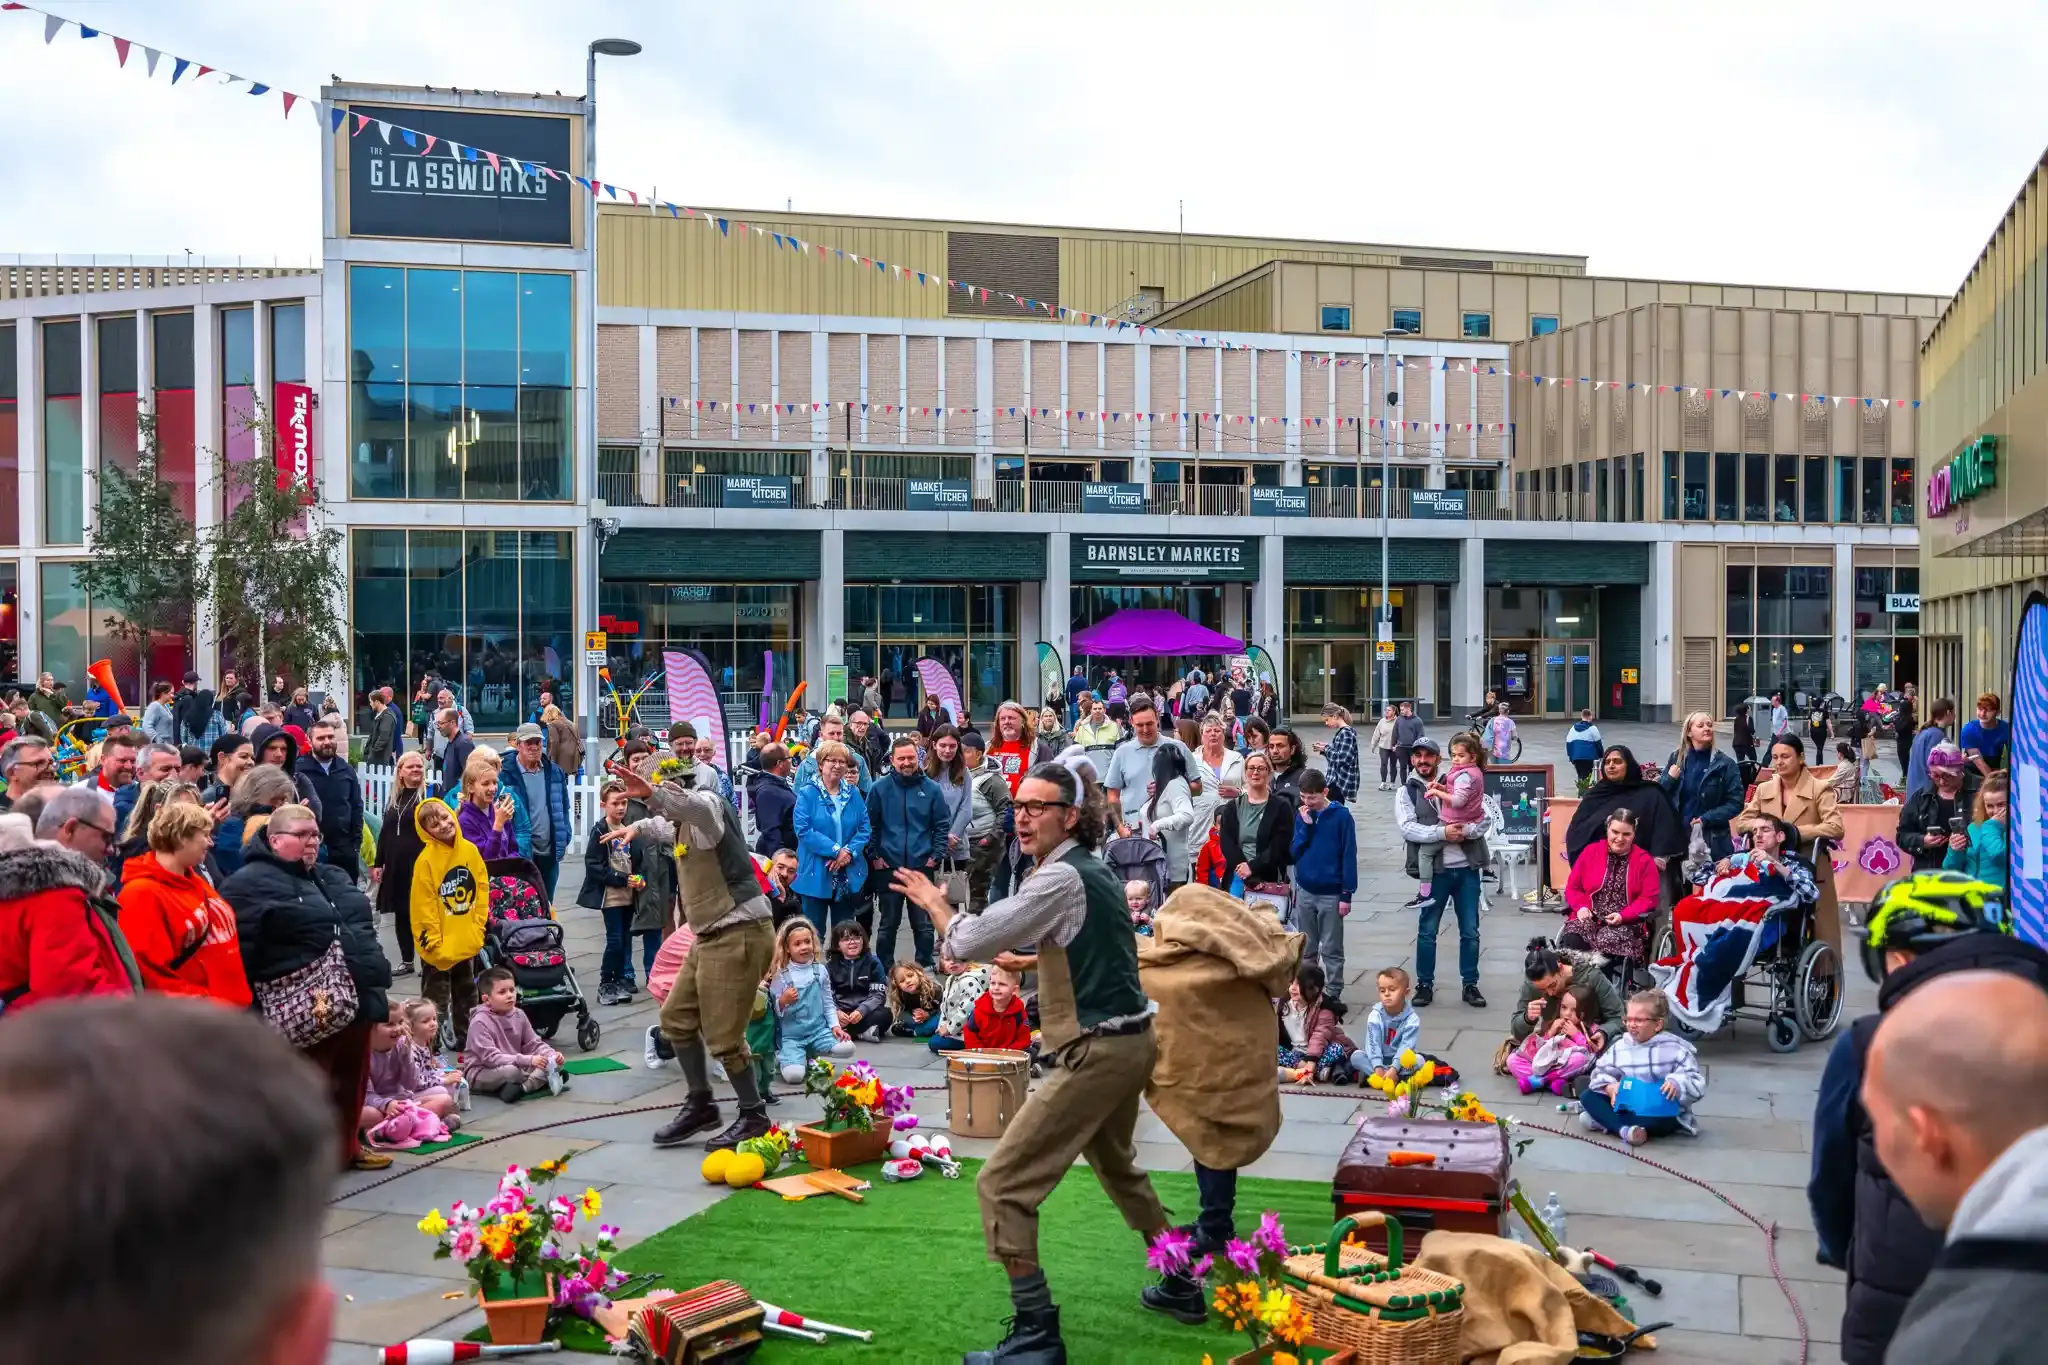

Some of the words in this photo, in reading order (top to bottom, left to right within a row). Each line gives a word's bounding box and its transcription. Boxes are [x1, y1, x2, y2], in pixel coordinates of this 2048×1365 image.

[370, 146, 383, 156] THE
[370, 159, 547, 195] GLASSWORKS
[727, 478, 762, 488] MARKET
[910, 481, 944, 492] MARKET
[752, 489, 787, 499] KITCHEN
[1086, 485, 1118, 495] MARKET
[1253, 488, 1284, 498] MARKET
[934, 492, 968, 502] KITCHEN
[1109, 495, 1141, 505] KITCHEN
[1413, 491, 1443, 501] MARKET
[1275, 498, 1306, 508] KITCHEN
[1433, 501, 1463, 511] KITCHEN
[1087, 545, 1166, 561] BARNSLEY
[1170, 546, 1240, 562] MARKETS
[1892, 598, 1919, 608] BLAC
[1499, 775, 1528, 783] FALCO
